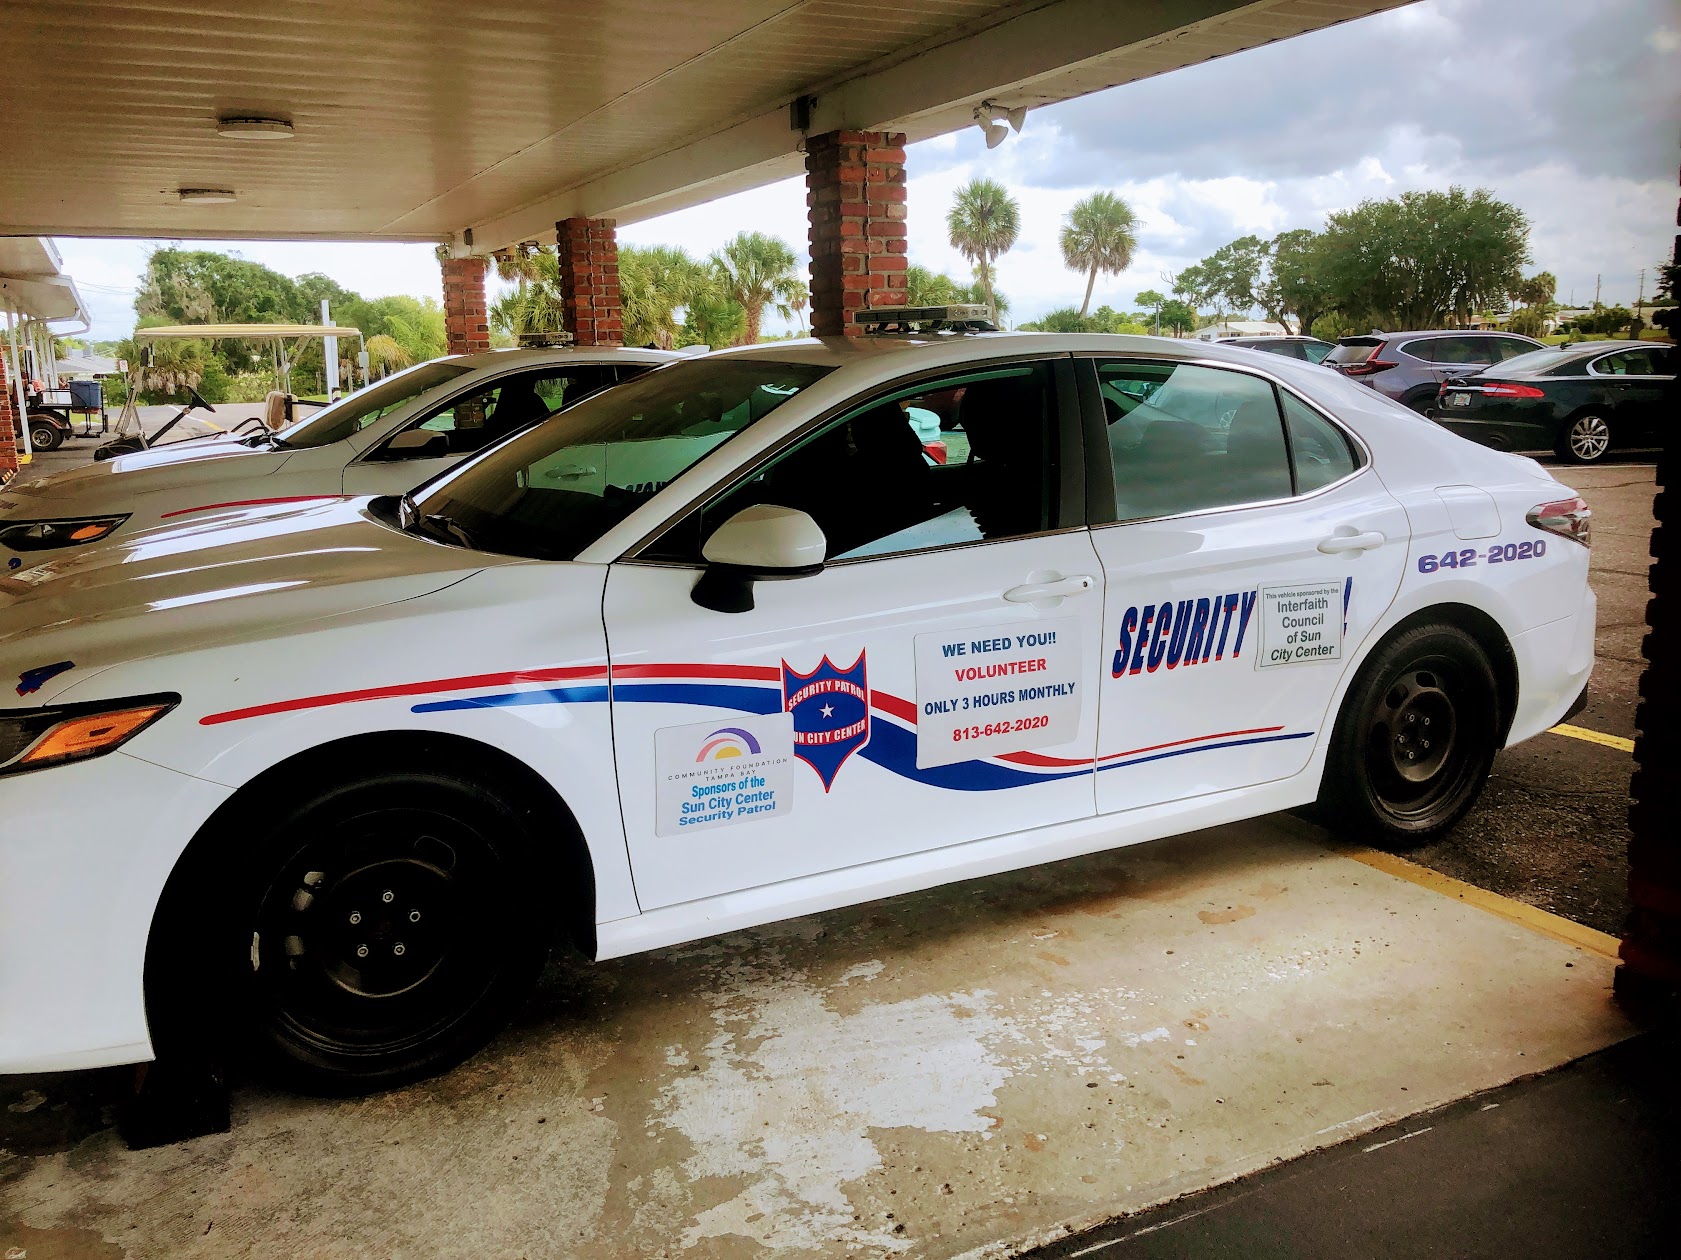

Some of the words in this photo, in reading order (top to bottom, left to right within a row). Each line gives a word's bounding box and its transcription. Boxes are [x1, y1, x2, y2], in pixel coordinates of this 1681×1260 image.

[1418, 540, 1547, 574] 642-2020
[1297, 588, 1323, 597] sponsored
[1277, 597, 1328, 613] Interfaith
[1282, 613, 1324, 629] Council
[942, 642, 966, 657] WE
[971, 637, 1012, 654] NEED
[1016, 631, 1057, 648] YOU!!
[1111, 590, 1257, 679] SECURITY
[1286, 631, 1299, 644] of
[1300, 630, 1321, 642] Sun
[1270, 648, 1293, 662] City
[1295, 644, 1334, 658] Center
[955, 658, 1047, 682] VOLUNTEER
[788, 680, 832, 711] SECURITY
[834, 680, 865, 702] PATROL
[924, 698, 959, 715] ONLY
[962, 697, 970, 710] 3
[973, 690, 1015, 708] HOURS
[1018, 681, 1076, 701] MONTHLY
[793, 731, 805, 743] UN
[807, 732, 831, 744] CITY
[833, 719, 866, 741] CENTER
[952, 714, 1049, 742] 813-642-2020
[668, 767, 725, 781] COMMUNITY
[730, 758, 788, 771] FOUNDATION
[706, 773, 735, 782] TAMPA
[740, 769, 757, 777] BAY
[691, 782, 737, 799] Sponsors
[738, 777, 748, 790] of
[750, 775, 766, 788] the
[679, 810, 734, 826] Security
[737, 801, 776, 816] Patrol
[681, 801, 706, 814] Sun
[708, 796, 733, 811] City
[735, 790, 775, 805] Center
